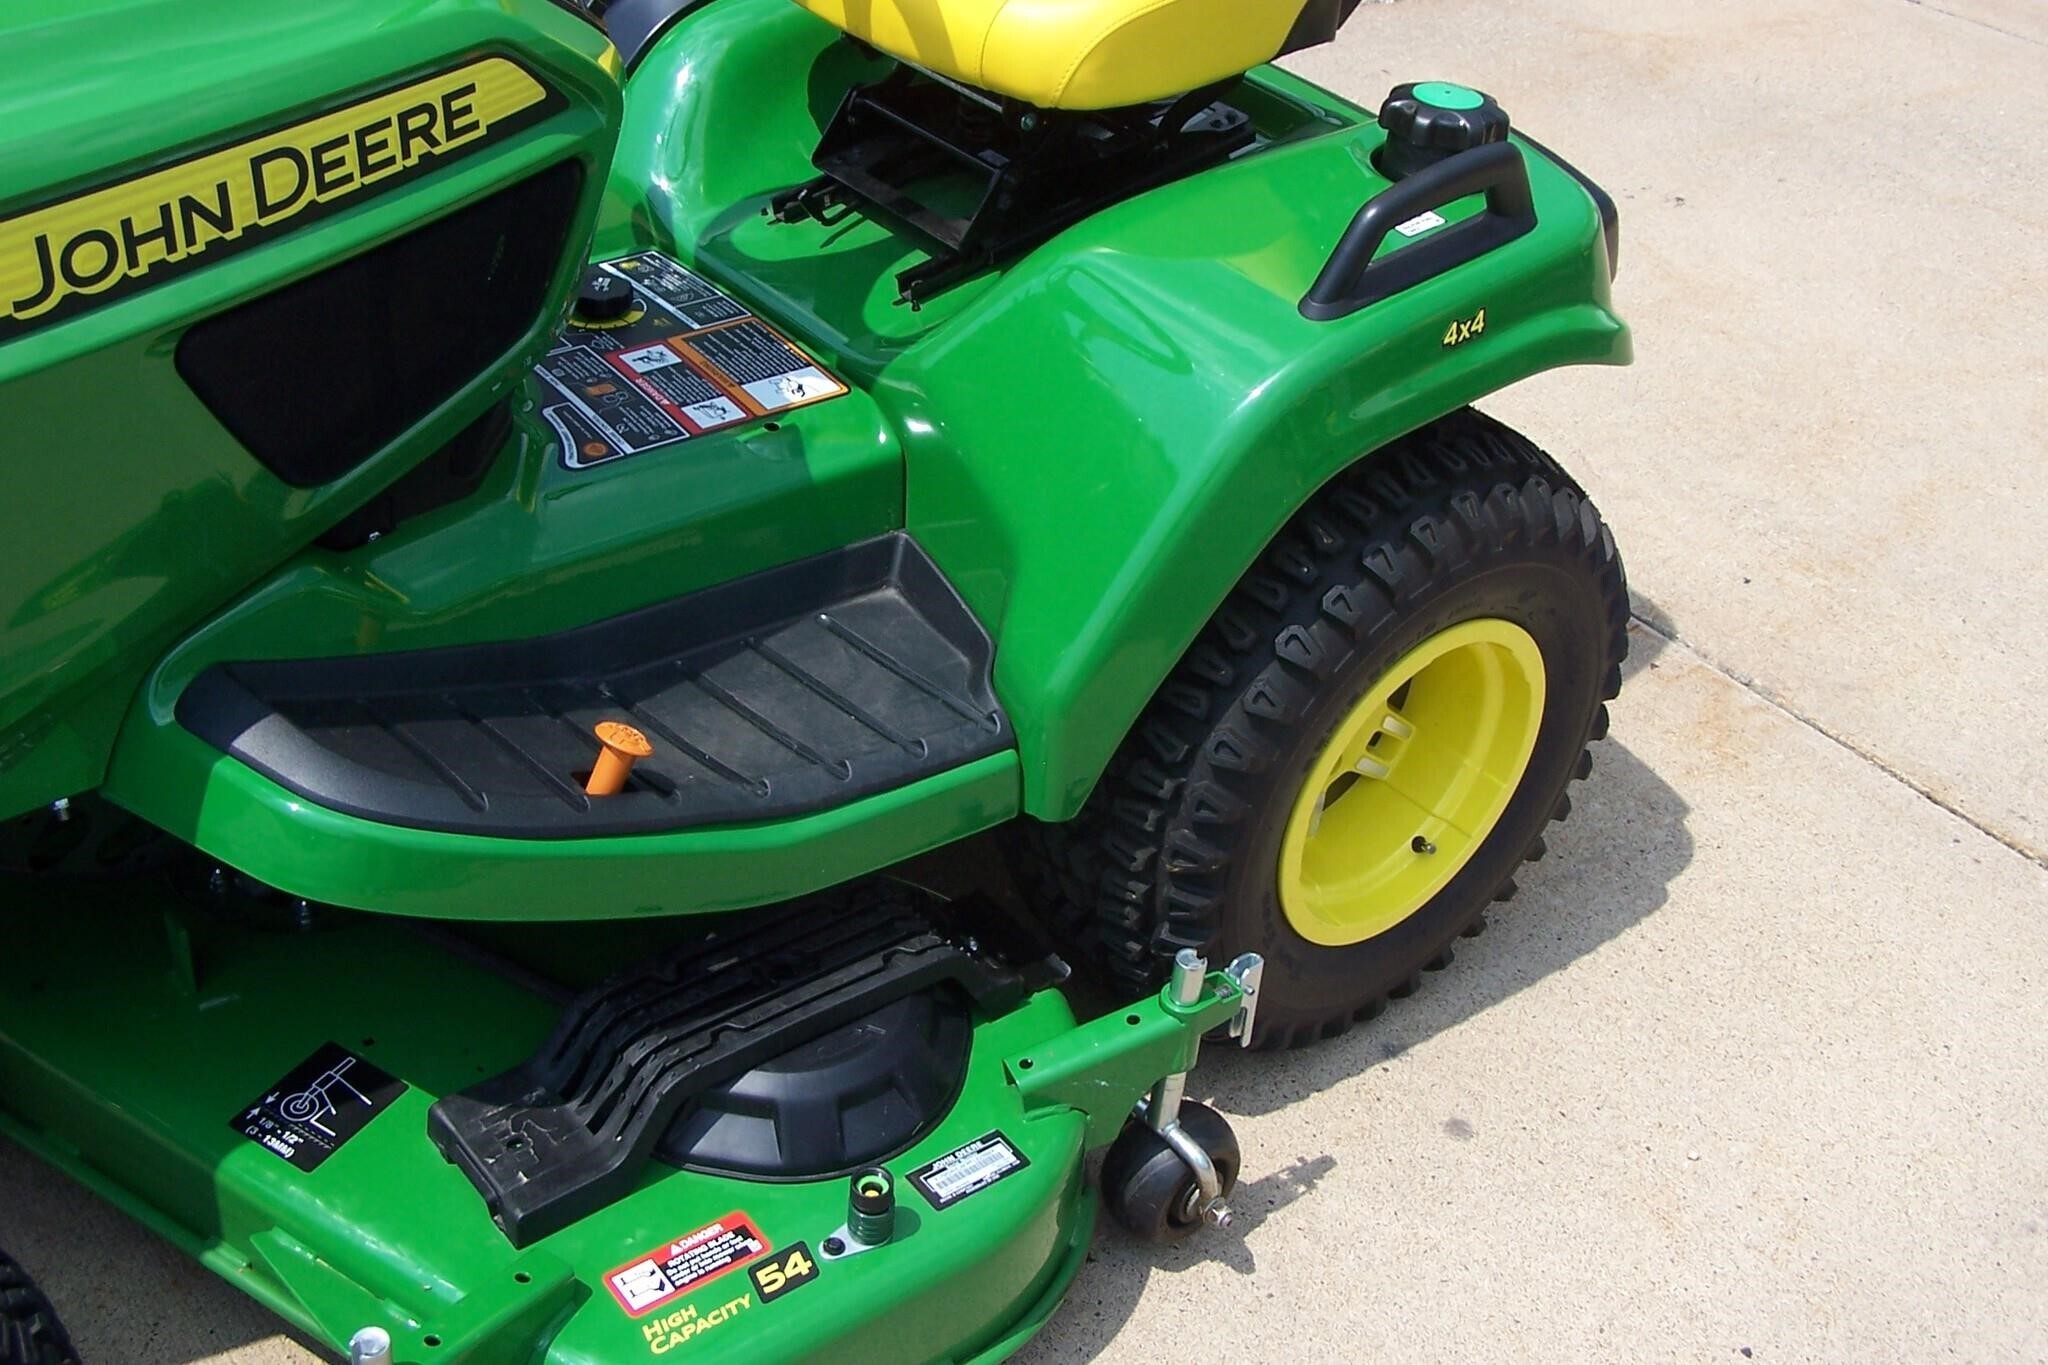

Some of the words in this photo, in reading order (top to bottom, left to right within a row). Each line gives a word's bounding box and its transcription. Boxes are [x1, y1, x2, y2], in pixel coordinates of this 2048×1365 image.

[11, 180, 236, 315] JOHN
[249, 82, 482, 220] DEERE
[1442, 308, 1485, 346] 4x4
[282, 1131, 304, 1144] 1/2"
[932, 1154, 956, 1170] JOHN
[954, 1141, 983, 1159] DEERE
[667, 1244, 709, 1268] ROTATING
[707, 1231, 735, 1248] BLADE
[679, 1223, 724, 1247] DANGER
[755, 1250, 813, 1294] 54
[641, 1304, 698, 1342] HIGH
[650, 1293, 752, 1354] CAPACITY
